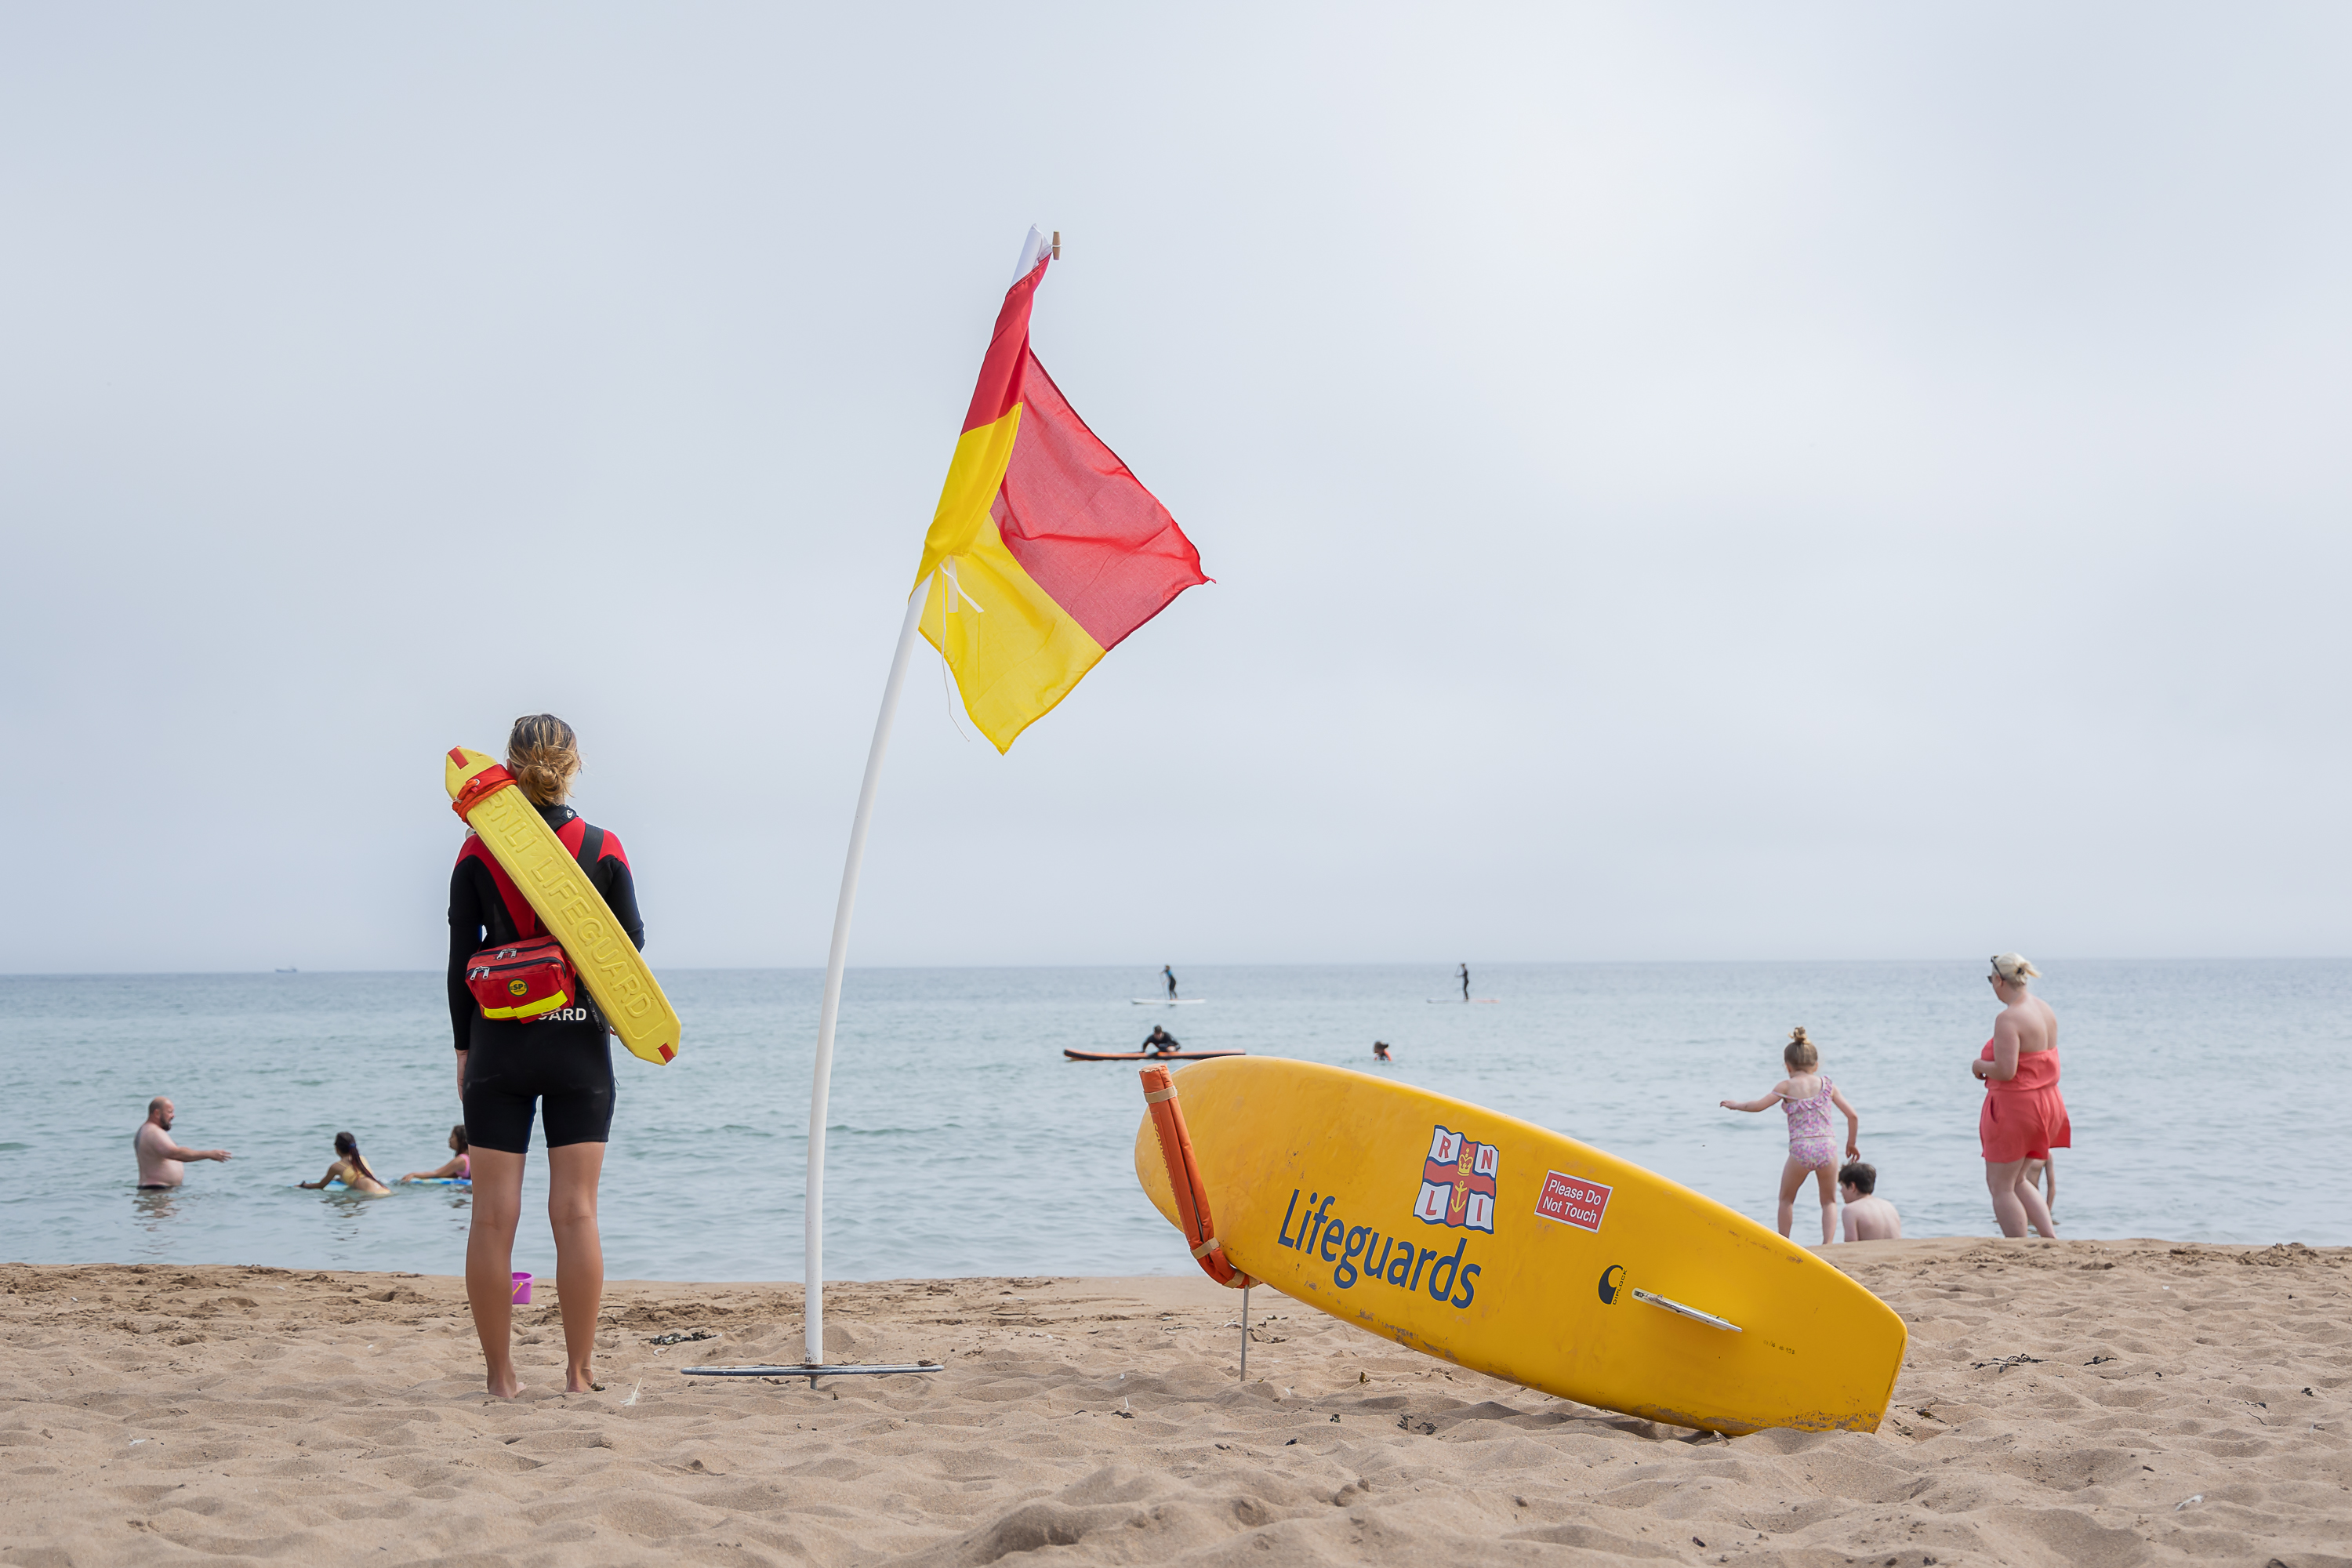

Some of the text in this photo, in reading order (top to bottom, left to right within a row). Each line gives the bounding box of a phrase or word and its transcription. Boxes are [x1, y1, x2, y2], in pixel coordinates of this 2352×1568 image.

[480, 791, 652, 1018] RNLI LIFEGUARD
[538, 1007, 587, 1021] ARD
[1548, 1178, 1602, 1206] Please Do
[1542, 1196, 1597, 1224] Not Touch
[1277, 1189, 1482, 1309] Lifeguards
[1612, 1269, 1628, 1305] DIPLOCK
